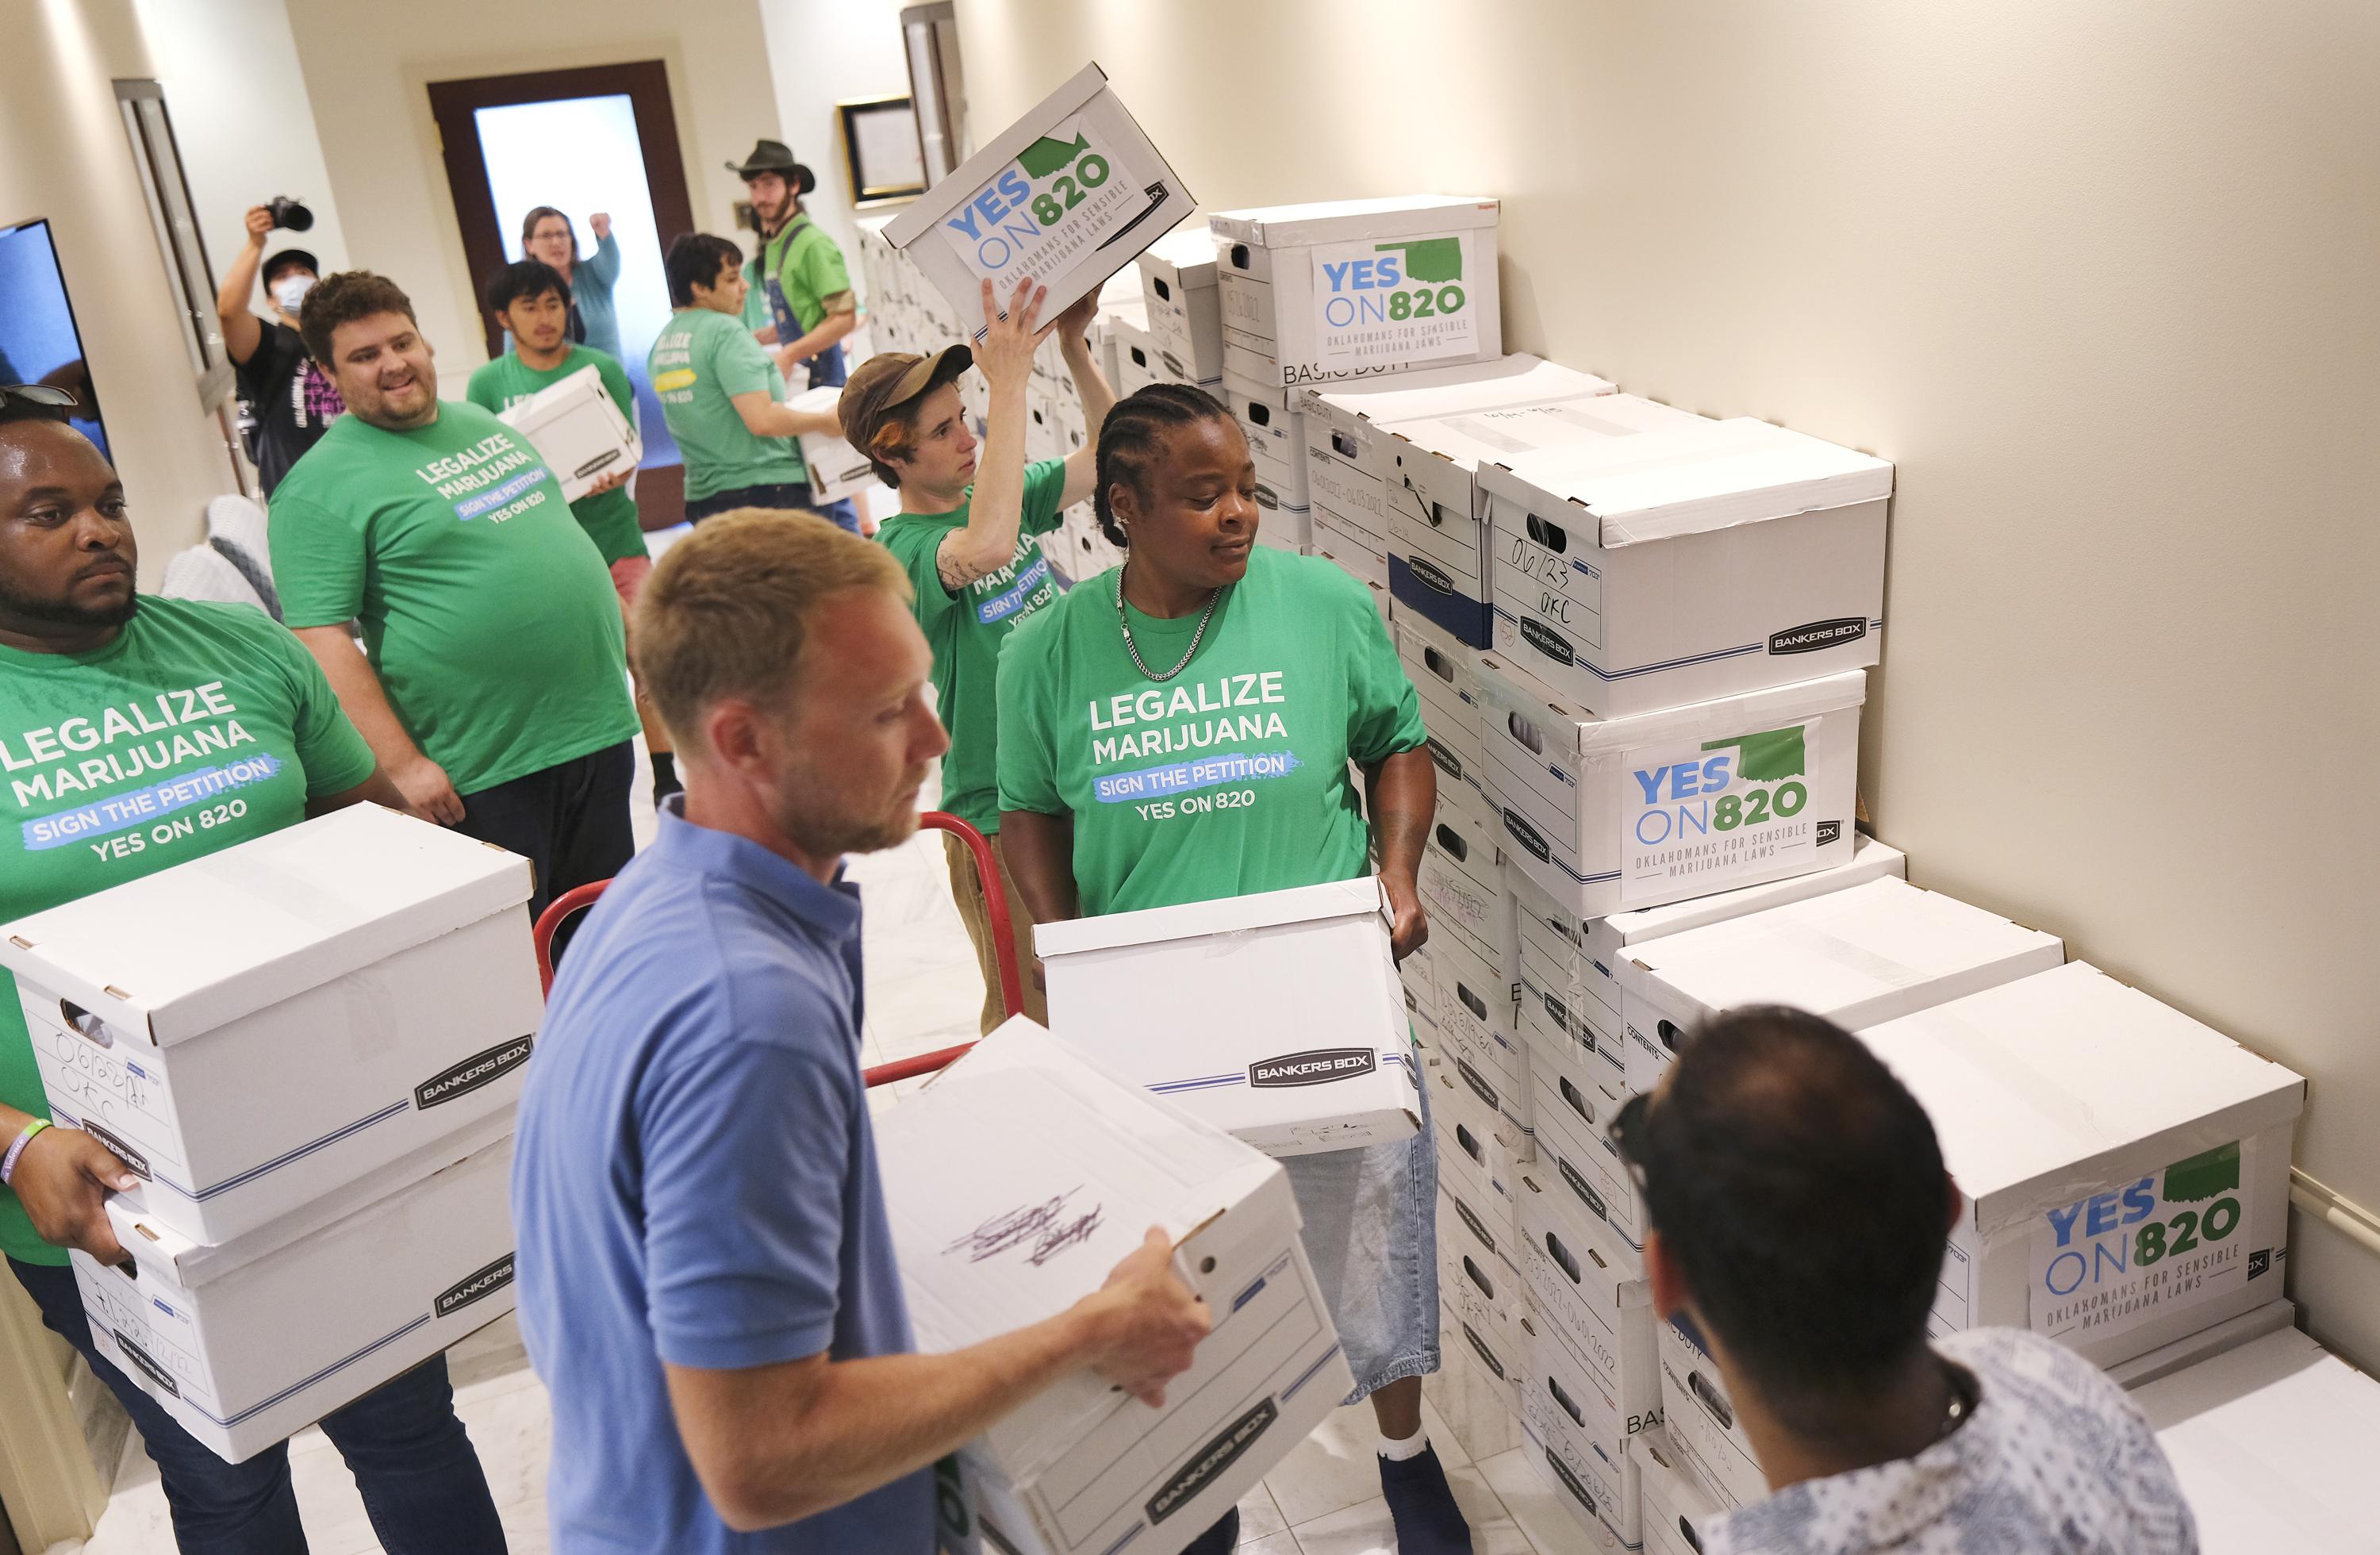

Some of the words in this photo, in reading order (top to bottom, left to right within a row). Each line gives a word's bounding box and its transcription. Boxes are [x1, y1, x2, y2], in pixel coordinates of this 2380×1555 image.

[947, 170, 1031, 241] YES
[978, 211, 1041, 269] ON
[1031, 153, 1110, 226] 820
[999, 237, 1061, 290] OKLAHOMANS
[1061, 218, 1082, 240] FOR
[1082, 182, 1128, 226] SENSIBLE
[1031, 236, 1085, 282] MARIJUANA
[1088, 212, 1114, 236] LAWS
[1322, 257, 1402, 293] YES
[1326, 294, 1384, 328] ON
[1388, 285, 1465, 321] 820
[1326, 329, 1395, 347] OKLAHOMANS
[1397, 326, 1415, 339] FOR
[1355, 340, 1411, 357] MARIJUANA
[416, 432, 516, 485] LEGALIZE
[437, 450, 533, 500] MARIJUANA
[459, 499, 486, 517] SIGN
[482, 490, 505, 505] THE
[501, 468, 545, 497] PETITION
[487, 508, 512, 524] YES
[509, 500, 529, 515] ON
[526, 490, 546, 507] 820
[983, 597, 1012, 618] SIGN
[1016, 557, 1047, 593] ETITIO
[1411, 562, 1438, 586] BANKERS
[1438, 578, 1451, 590] BOX
[1512, 539, 1569, 589] 06/23
[1541, 592, 1571, 624] OKC
[1523, 623, 1556, 649] BANKERS
[1555, 643, 1571, 657] BOX
[1775, 629, 1834, 649] BANKERS
[1835, 622, 1862, 638] BOX
[0, 681, 236, 772] LEGALIZE
[1089, 671, 1285, 731] LEGALIZE
[10, 720, 256, 808] MARIJUANA
[1092, 712, 1288, 766] MARIJUANA
[33, 809, 101, 843] SIGN
[102, 793, 157, 823] THE
[157, 758, 271, 807] PETITION
[1100, 773, 1144, 798] SIGN
[1146, 766, 1188, 789] THE
[1193, 755, 1285, 783] PETITION
[1633, 755, 1732, 806] YES
[90, 832, 147, 862] YES
[151, 816, 195, 846] ON
[198, 799, 248, 829] 820
[1135, 801, 1177, 822] YES
[1180, 795, 1212, 815] ON
[1215, 789, 1256, 810] 820
[1636, 799, 1709, 846] ON
[1712, 781, 1809, 833] 820
[1506, 814, 1534, 847] BANKERS
[1533, 841, 1548, 857] BOX
[1636, 843, 1718, 870] OKLAHOMANS
[1724, 835, 1746, 851] FOR
[1751, 822, 1809, 847] SENSIBLE
[1818, 827, 1835, 838] OX
[1668, 854, 1739, 878] MARIJUANA
[1745, 846, 1776, 863] LAWS
[421, 1056, 496, 1101] BANKERS
[496, 1041, 529, 1069] BOX
[1257, 1060, 1332, 1080] BANKERS
[1334, 1054, 1369, 1069] BOX
[61, 1066, 115, 1128] OKC
[2046, 1177, 2157, 1249] YES
[2045, 1233, 2128, 1296] ON
[2132, 1196, 2241, 1267] 820
[440, 1265, 512, 1310] BANKERS
[2047, 1280, 2138, 1328] OKLAHOMANS
[2144, 1270, 2170, 1291] FOR
[2176, 1244, 2240, 1278] SENSIBLE
[2082, 1292, 2160, 1331] MARIJUANA
[2166, 1275, 2204, 1302] LAWS
[1155, 1437, 1234, 1514] BANKERS
[1233, 1409, 1270, 1444] BOX
